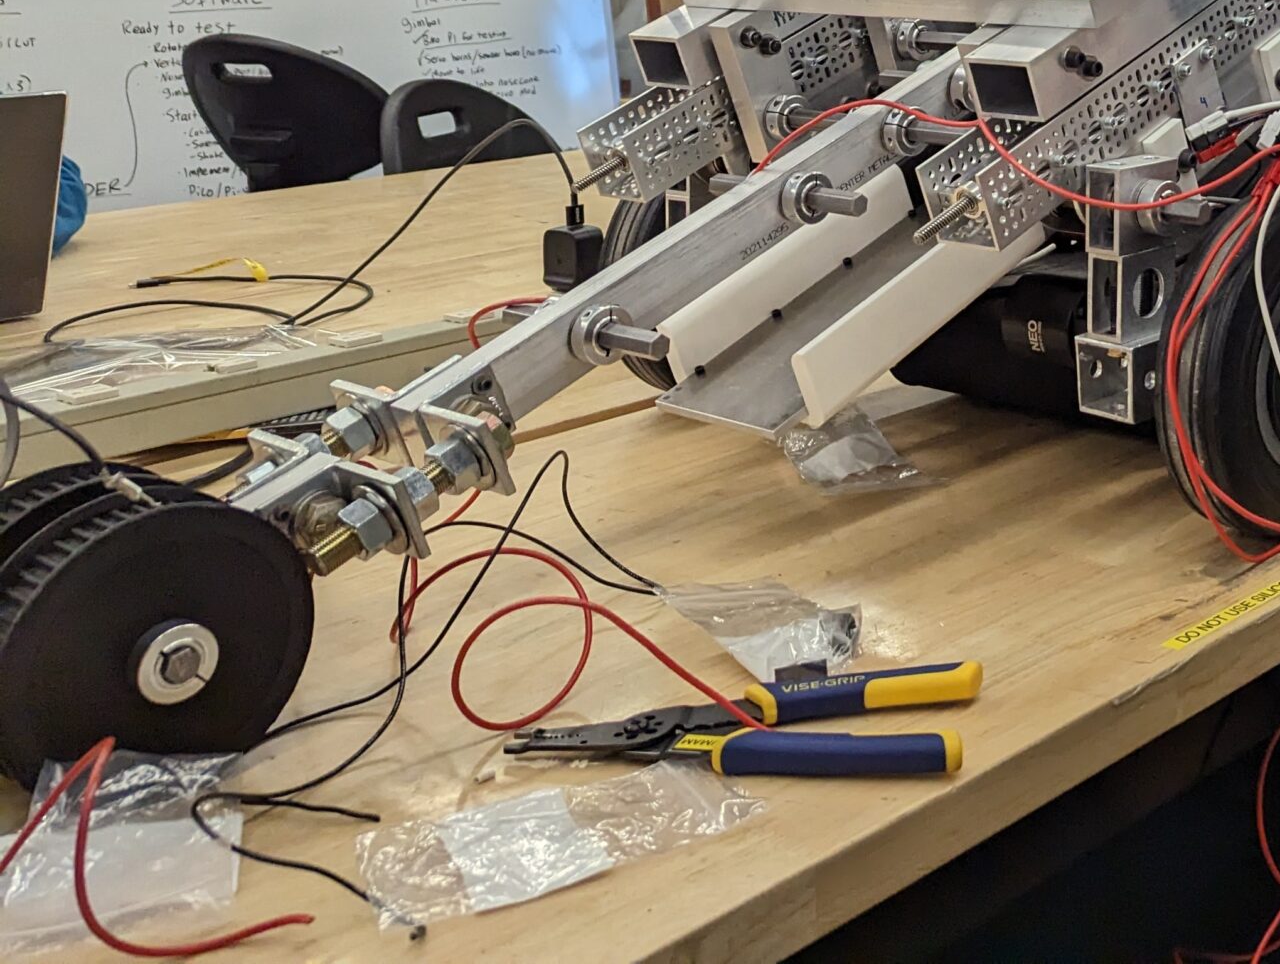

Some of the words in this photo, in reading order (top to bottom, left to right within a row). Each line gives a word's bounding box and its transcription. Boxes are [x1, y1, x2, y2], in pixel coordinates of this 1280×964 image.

[121, 20, 159, 35] Ready
[167, 20, 184, 34] to
[195, 22, 236, 35] test
[835, 170, 866, 191] ENTER
[1027, 319, 1041, 352] NEO
[1174, 629, 1201, 644] DO
[1196, 614, 1229, 633] NOT
[1223, 599, 1257, 618] USE
